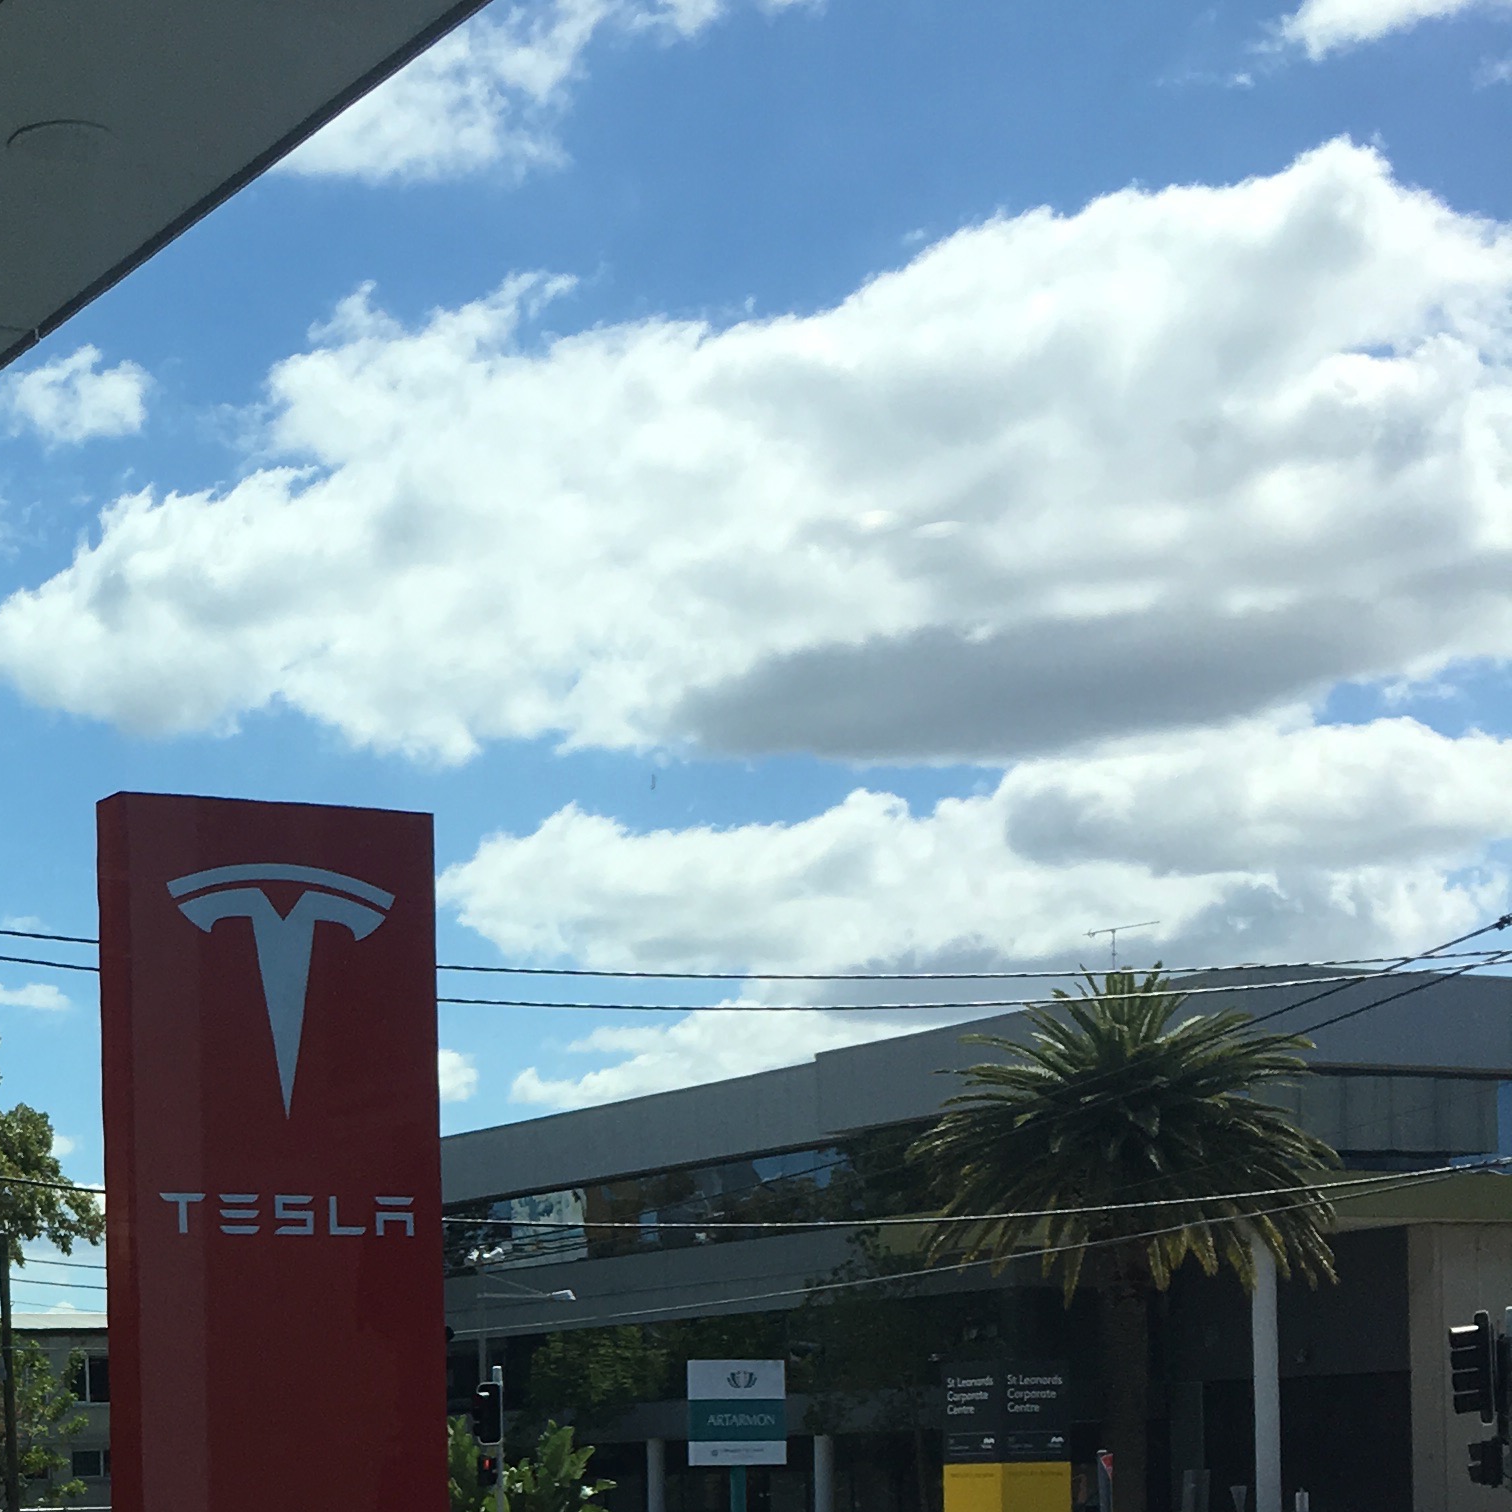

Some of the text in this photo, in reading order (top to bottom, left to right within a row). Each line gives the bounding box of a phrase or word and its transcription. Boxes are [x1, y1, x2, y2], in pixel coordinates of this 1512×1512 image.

[159, 1192, 415, 1237] TESLA
[947, 1375, 994, 1388] St Leonards
[1007, 1374, 1063, 1385] St Leonards
[947, 1390, 989, 1403] Corporate
[1007, 1388, 1057, 1401] Corporate
[947, 1404, 975, 1415] Centre
[1007, 1402, 1041, 1413] Centre
[707, 1413, 776, 1428] ARTARMON
